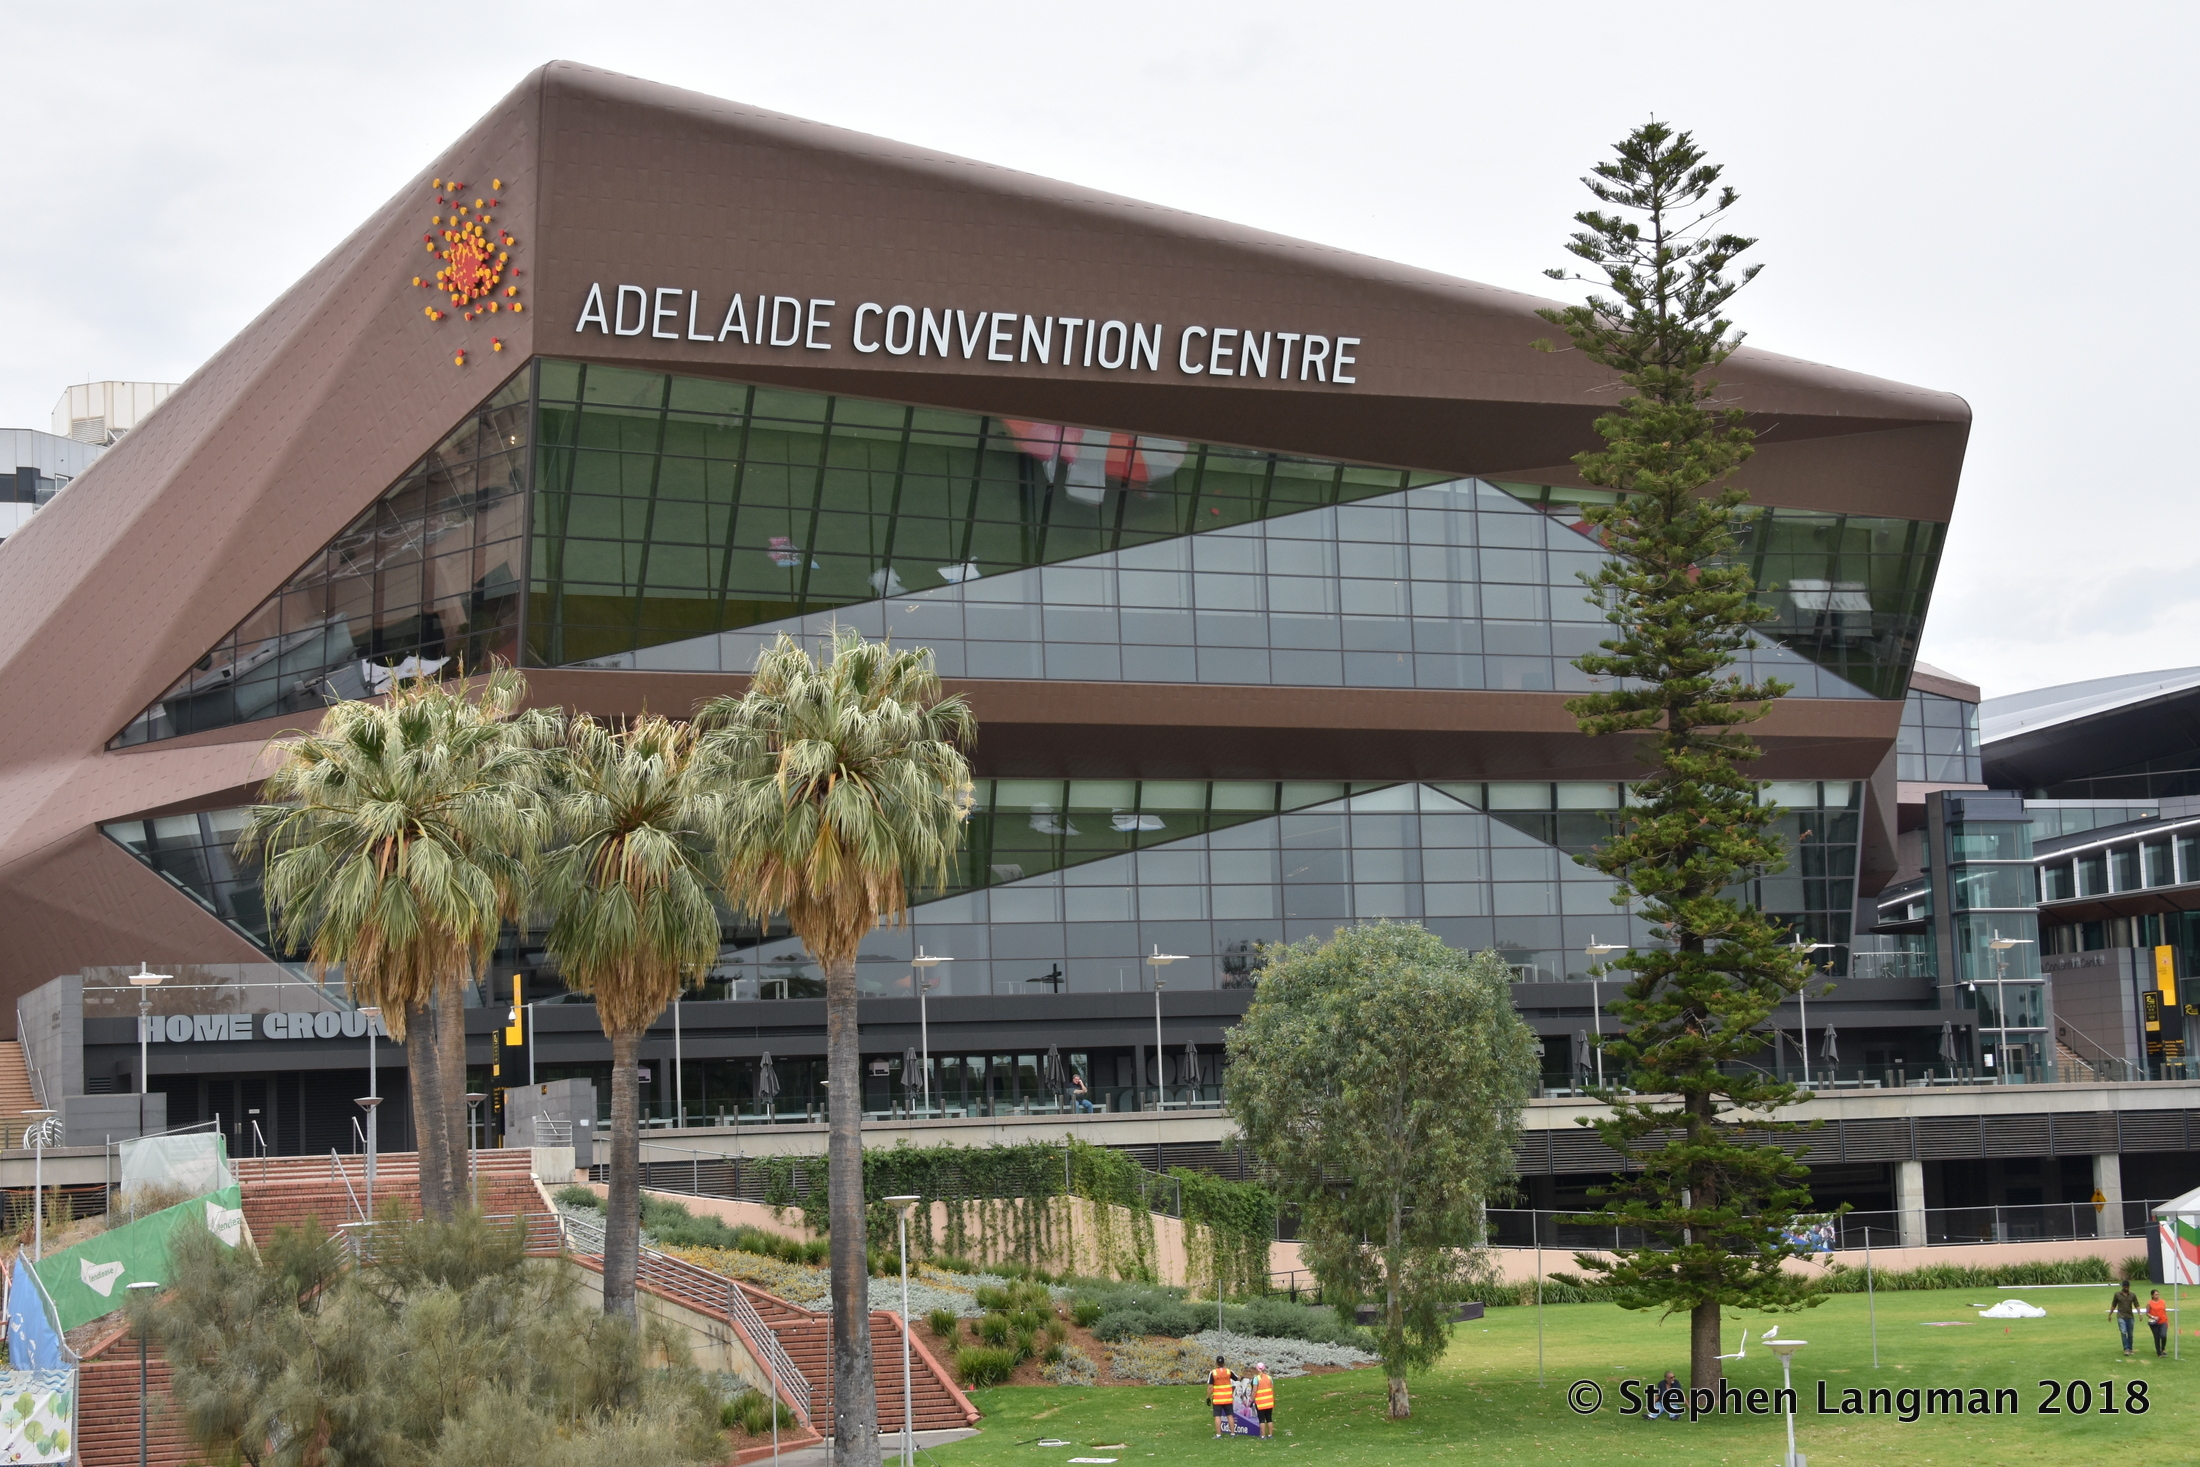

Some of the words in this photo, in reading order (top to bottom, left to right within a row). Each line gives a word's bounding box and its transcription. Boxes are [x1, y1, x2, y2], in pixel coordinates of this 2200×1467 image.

[575, 282, 836, 350] ADELAIDE
[852, 302, 1163, 371] CONVENTION
[1178, 325, 1361, 384] CENTRE
[138, 1014, 252, 1042] HOME
[262, 1011, 388, 1038] GROUN
[88, 1267, 114, 1283] lendlease
[1234, 1424, 1248, 1433] Zone
